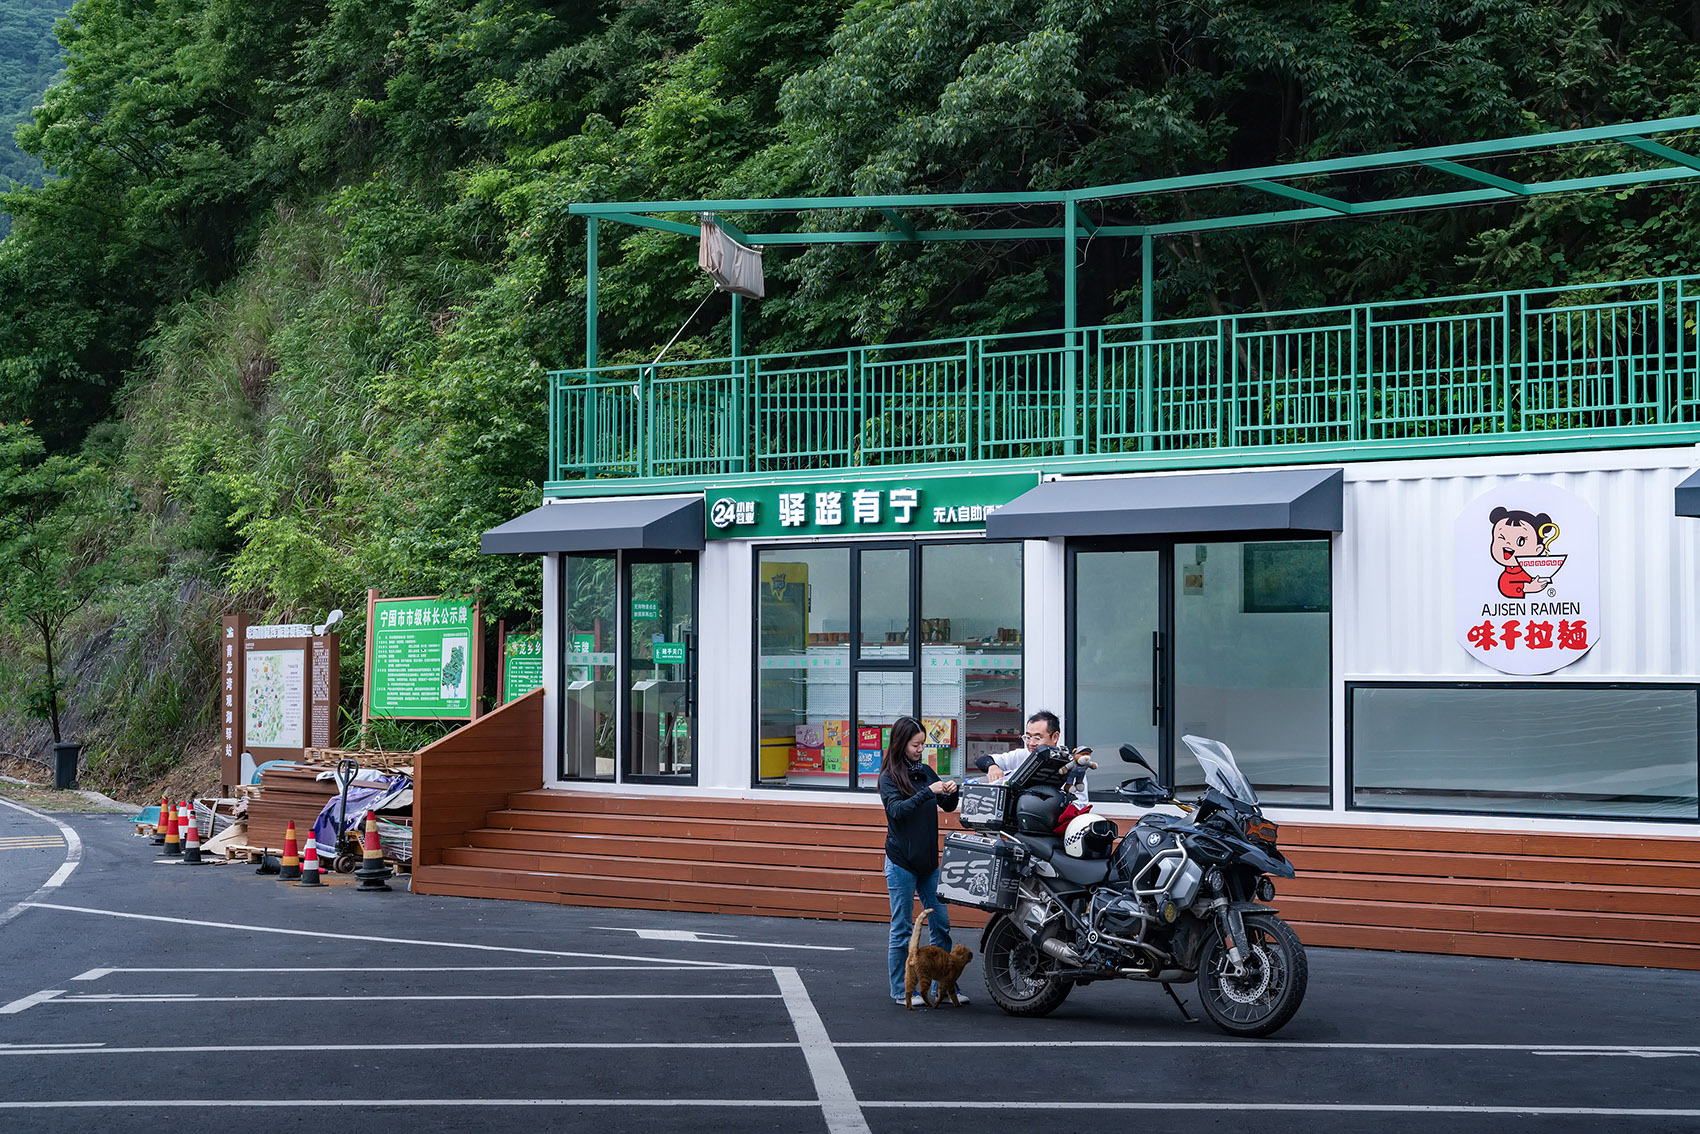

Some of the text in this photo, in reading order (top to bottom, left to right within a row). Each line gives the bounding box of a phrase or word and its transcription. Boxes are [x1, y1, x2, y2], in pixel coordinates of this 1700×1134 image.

[714, 503, 736, 523] 24
[779, 488, 919, 527] 驿路有宁
[933, 504, 1003, 523] 无人自助便
[380, 606, 467, 628] 宁国市市级林长公示牌
[1481, 602, 1581, 617] AJISEN RAMEN
